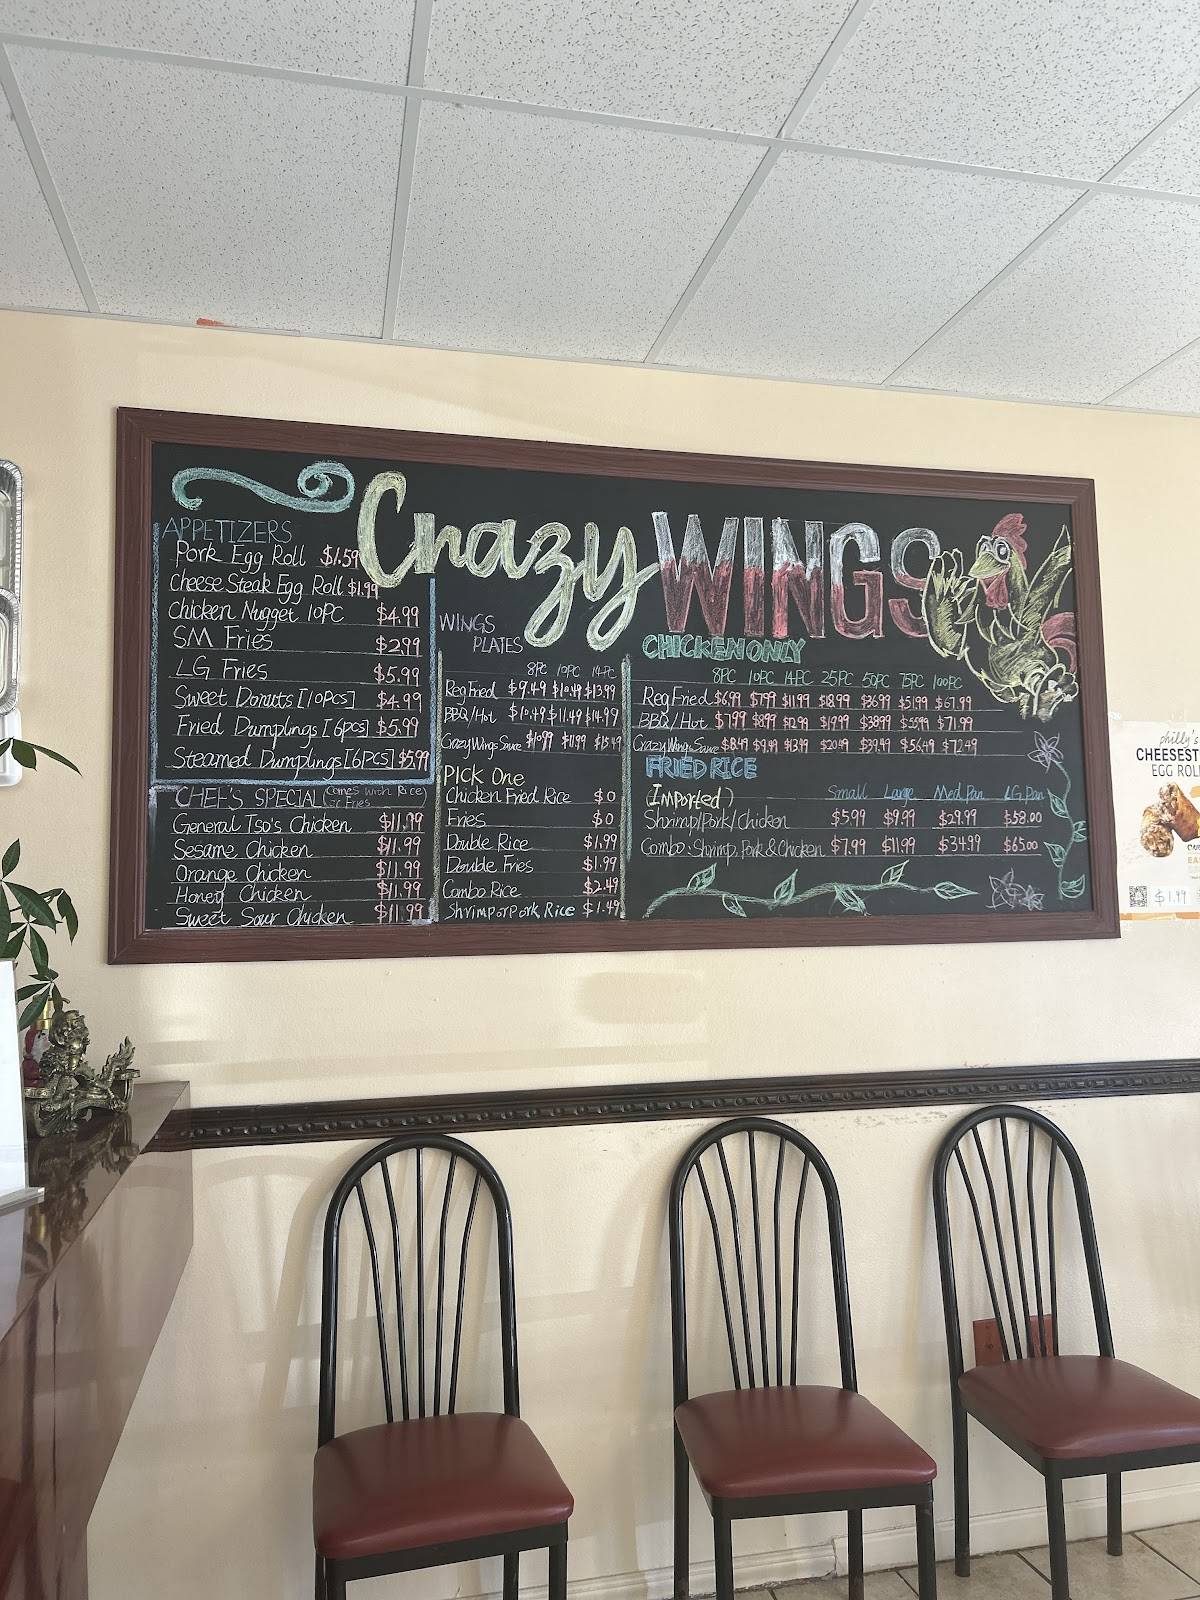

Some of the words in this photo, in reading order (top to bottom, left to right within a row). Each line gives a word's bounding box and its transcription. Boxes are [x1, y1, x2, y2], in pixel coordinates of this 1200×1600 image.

[162, 517, 294, 543] APPETIZERS
[176, 540, 222, 567] Pork
[231, 545, 263, 573] Egg
[272, 545, 306, 567] Roll
[320, 544, 359, 569] $1.59
[356, 471, 661, 650] Crazy
[652, 511, 940, 640] WINGS
[170, 568, 225, 592] Cheese
[228, 571, 271, 593] Steak
[277, 574, 303, 604] Egg
[312, 574, 344, 596] Roll
[348, 579, 378, 599] $1.99
[168, 599, 236, 619] Chicken
[242, 600, 299, 632] Nugget
[308, 603, 344, 624] 10PC
[377, 602, 419, 627] $4.99
[440, 612, 496, 634] WINGS
[173, 626, 213, 648] SM
[224, 626, 273, 650] Fries
[376, 635, 419, 656] $2.99
[473, 636, 523, 654] PLATES
[642, 634, 745, 661] CHICKEN
[746, 638, 806, 663] ONLY
[176, 656, 210, 680] LG
[222, 658, 268, 680] Fries
[374, 662, 419, 687] $5.99
[527, 661, 547, 677] 8PC
[557, 664, 580, 678] 10PC
[592, 664, 617, 680] 14PC
[712, 667, 736, 683] 8PC
[749, 669, 774, 685] 10PC
[785, 669, 814, 686] 14PC
[821, 670, 853, 686] 25PC
[862, 672, 890, 689] 50PC
[899, 672, 924, 689] 75PC
[933, 674, 963, 690] 100PC
[175, 685, 228, 709] Sweet
[236, 686, 293, 709] Donuts
[377, 690, 421, 713] $4.99
[445, 680, 467, 705] Reg
[468, 681, 498, 699] Fried
[508, 680, 546, 700] $9.49
[552, 680, 582, 699] $10.49
[584, 681, 616, 701] $13.99
[642, 686, 669, 714] Reg
[671, 686, 713, 706] Fried
[714, 690, 740, 707] $6.99
[898, 695, 928, 710] $51.99
[935, 695, 972, 711] $67.99
[508, 702, 546, 723] $10.49
[547, 704, 582, 726] $11.49
[586, 707, 618, 727] $14.99
[937, 715, 973, 731] $71.99
[177, 713, 224, 736] Fried
[234, 716, 318, 749] Dumplings
[377, 716, 418, 738] $5.99
[440, 732, 471, 759] Crazy
[472, 737, 499, 760] Wings
[500, 735, 523, 751] Sauce
[633, 734, 666, 758] Crazy
[694, 737, 719, 754] Sauce
[752, 738, 778, 753] $9.49
[173, 744, 253, 769] Steamed
[260, 747, 342, 780] Dumplings
[399, 748, 430, 771] $5.99
[646, 755, 707, 779] FRIED
[710, 756, 759, 779] RICE
[1151, 764, 1173, 777] EGG
[492, 767, 525, 786] One
[255, 787, 321, 808] SPECIAL
[365, 785, 391, 797] with
[346, 797, 371, 808] Fries
[446, 785, 501, 804] Chicken
[505, 786, 539, 805] Fried
[543, 787, 573, 805] Rice
[827, 783, 869, 800] Small
[883, 783, 915, 807] Large
[967, 785, 985, 804] Pan
[1003, 784, 1022, 800] LG
[1026, 787, 1045, 805] Pan
[173, 813, 241, 834] General
[246, 814, 282, 833] Tso's
[290, 812, 352, 833] Chicken
[379, 812, 423, 833] $11.99
[447, 808, 486, 828] Fries
[830, 808, 866, 827] $5.99
[883, 808, 915, 827] $9.99
[939, 808, 977, 828] $29.99
[1003, 809, 1042, 827] $58.00
[174, 839, 237, 860] Sesame
[246, 837, 313, 858] Chicken
[377, 834, 421, 856] $11.99
[447, 833, 494, 851] Double
[497, 832, 533, 852] Rice
[584, 833, 617, 851] $1.99
[741, 837, 766, 859] Pork
[779, 838, 825, 857] Chicken
[831, 835, 866, 856] $7.99
[881, 835, 916, 855] $11.99
[939, 833, 981, 855] $34.99
[176, 864, 237, 892] Orange
[246, 861, 311, 881] Chicken
[376, 859, 420, 880] $11.99
[446, 855, 497, 873] Double
[503, 854, 534, 873] Fries
[582, 855, 617, 872] $1.99
[176, 885, 224, 913] Honey
[240, 883, 311, 902] Chicken
[377, 880, 421, 900] $11.99
[442, 879, 486, 899] Combo
[490, 879, 522, 898] Rice
[583, 876, 618, 896] $2.49
[175, 907, 232, 927] Sweet
[241, 907, 280, 925] Sour
[287, 905, 354, 925] Chicken
[375, 901, 423, 924] $11.99
[544, 901, 575, 917] Rice
[583, 898, 620, 918] $1.49
